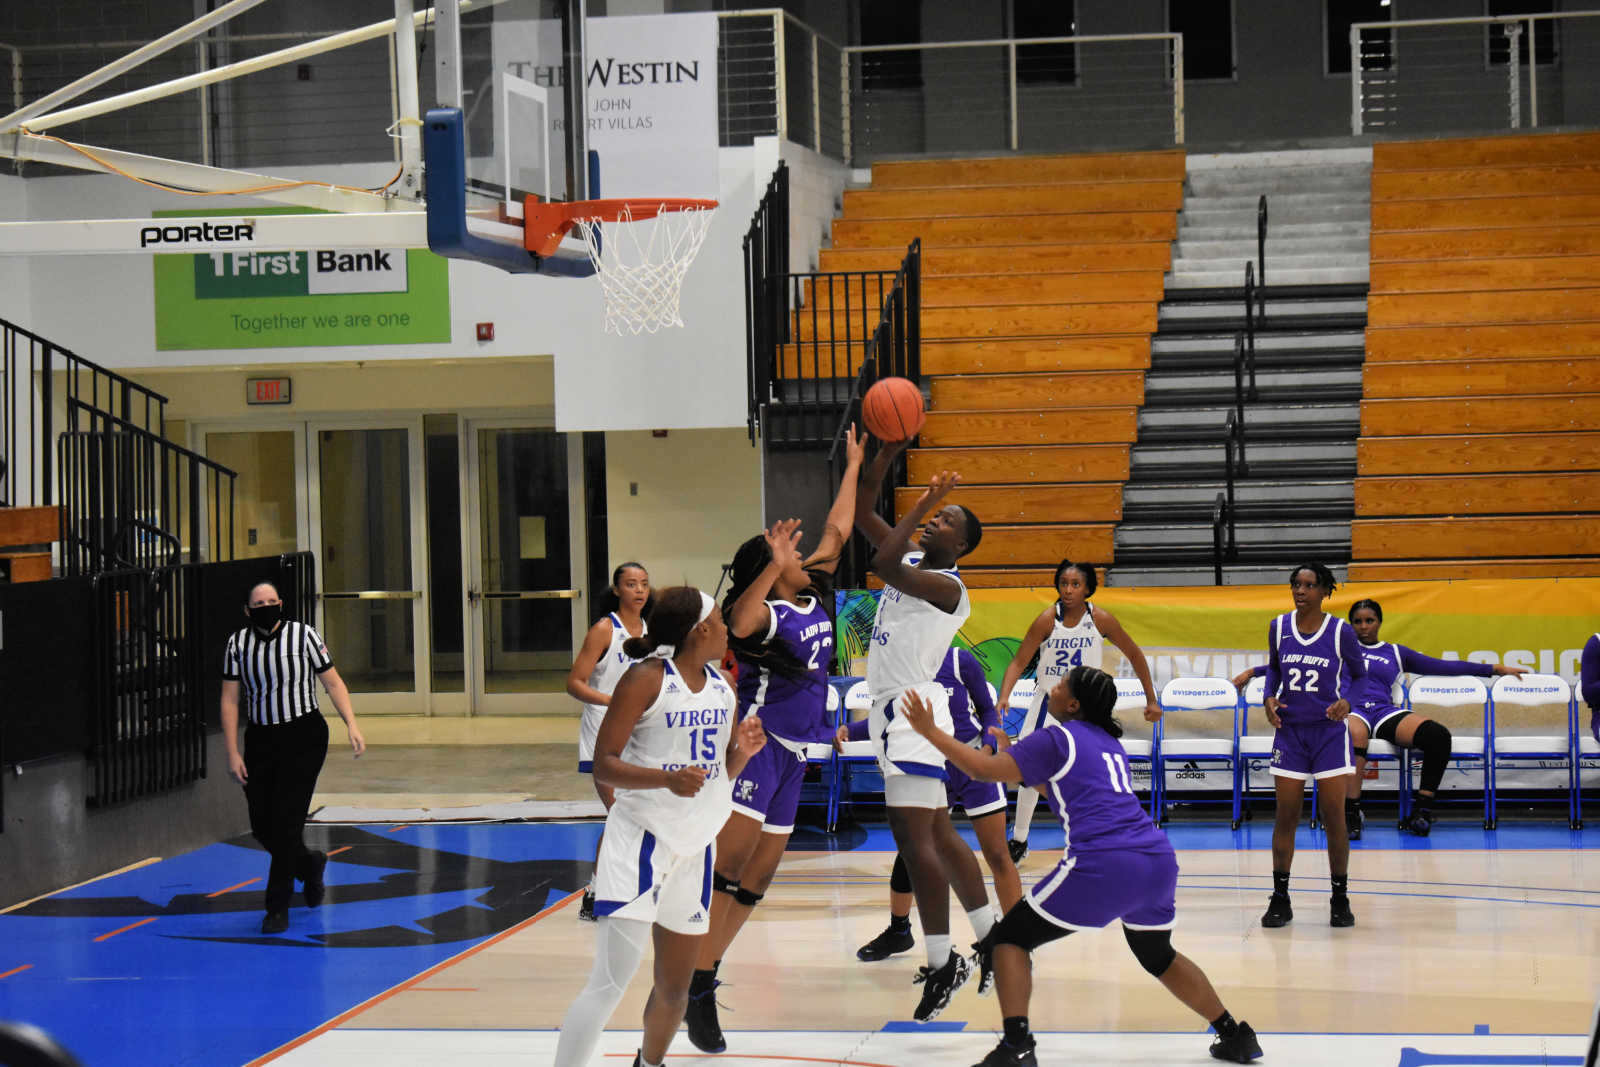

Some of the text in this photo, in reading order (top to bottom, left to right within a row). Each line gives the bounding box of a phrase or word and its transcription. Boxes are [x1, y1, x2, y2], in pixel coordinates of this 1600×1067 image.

[594, 98, 631, 112] JOHN
[608, 116, 652, 130] VILLAS
[316, 249, 392, 273] Bank
[231, 312, 410, 334] Together we are one
[256, 381, 280, 401] EXIT
[1046, 636, 1095, 649] VIRGIN
[1055, 648, 1083, 667] 24
[1282, 653, 1330, 668] LADY BUFFS
[1288, 667, 1320, 692] 22
[664, 708, 729, 729] VIRGIN
[689, 728, 718, 760] 15
[1101, 752, 1133, 794] 11
[1175, 771, 1206, 780] adidas
